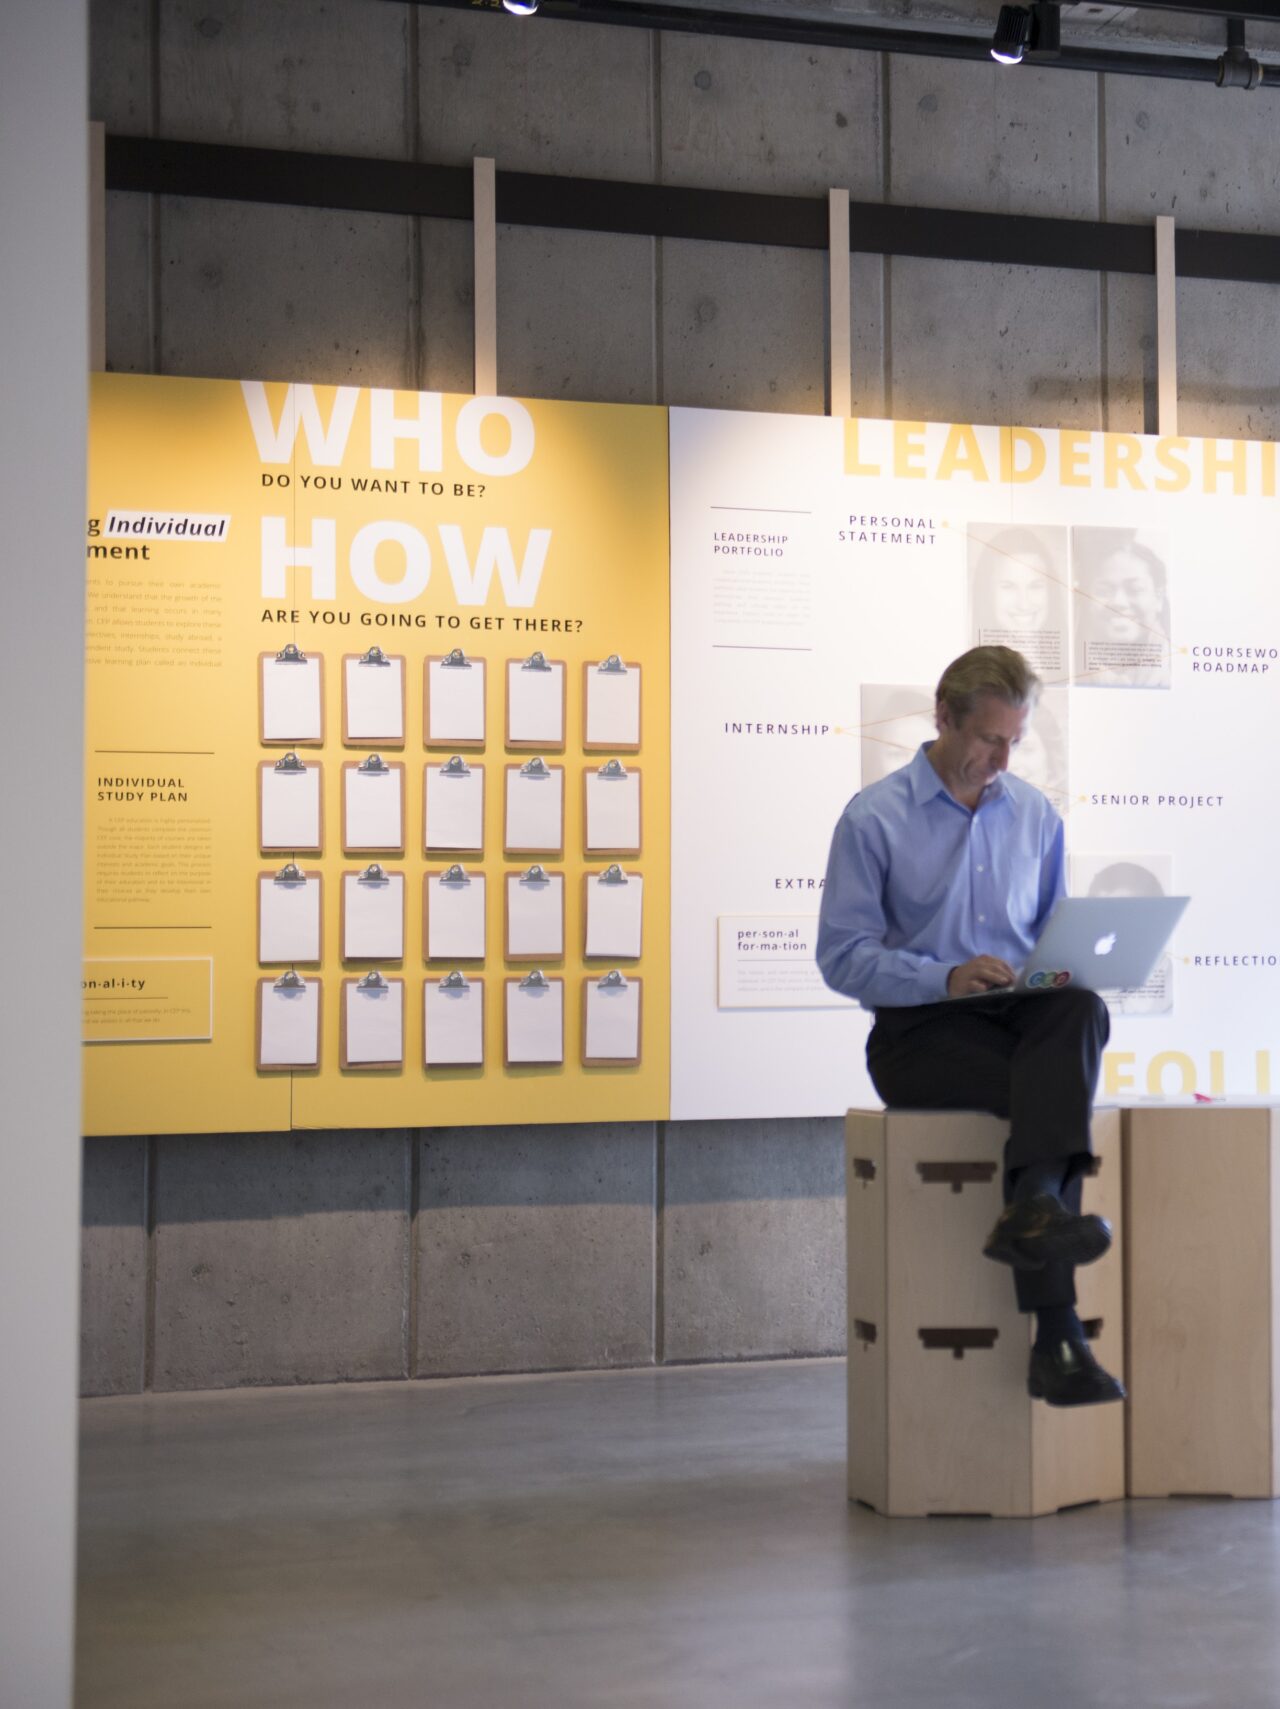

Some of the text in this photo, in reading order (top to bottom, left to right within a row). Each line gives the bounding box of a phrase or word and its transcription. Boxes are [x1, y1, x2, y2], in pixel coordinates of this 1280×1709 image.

[240, 381, 535, 477] WHO
[262, 473, 486, 498] DO YOU WANT TO BE?
[108, 516, 225, 537] Individual
[849, 515, 936, 529] PERSONAL
[714, 532, 788, 544] LEADERSHIP
[838, 530, 936, 545] STATEMENT
[714, 545, 784, 557] PORTFOLIO
[261, 515, 552, 608] HOW
[261, 608, 584, 634] ARE YOU GOING TO GET THERE?
[1192, 661, 1270, 675] ROADMAP
[724, 722, 830, 736] INTERNSHIP
[97, 777, 185, 789] INDIVIDUAL
[97, 791, 189, 803] STUDY PLAN
[1091, 794, 1224, 808] SENIOR PROJECT
